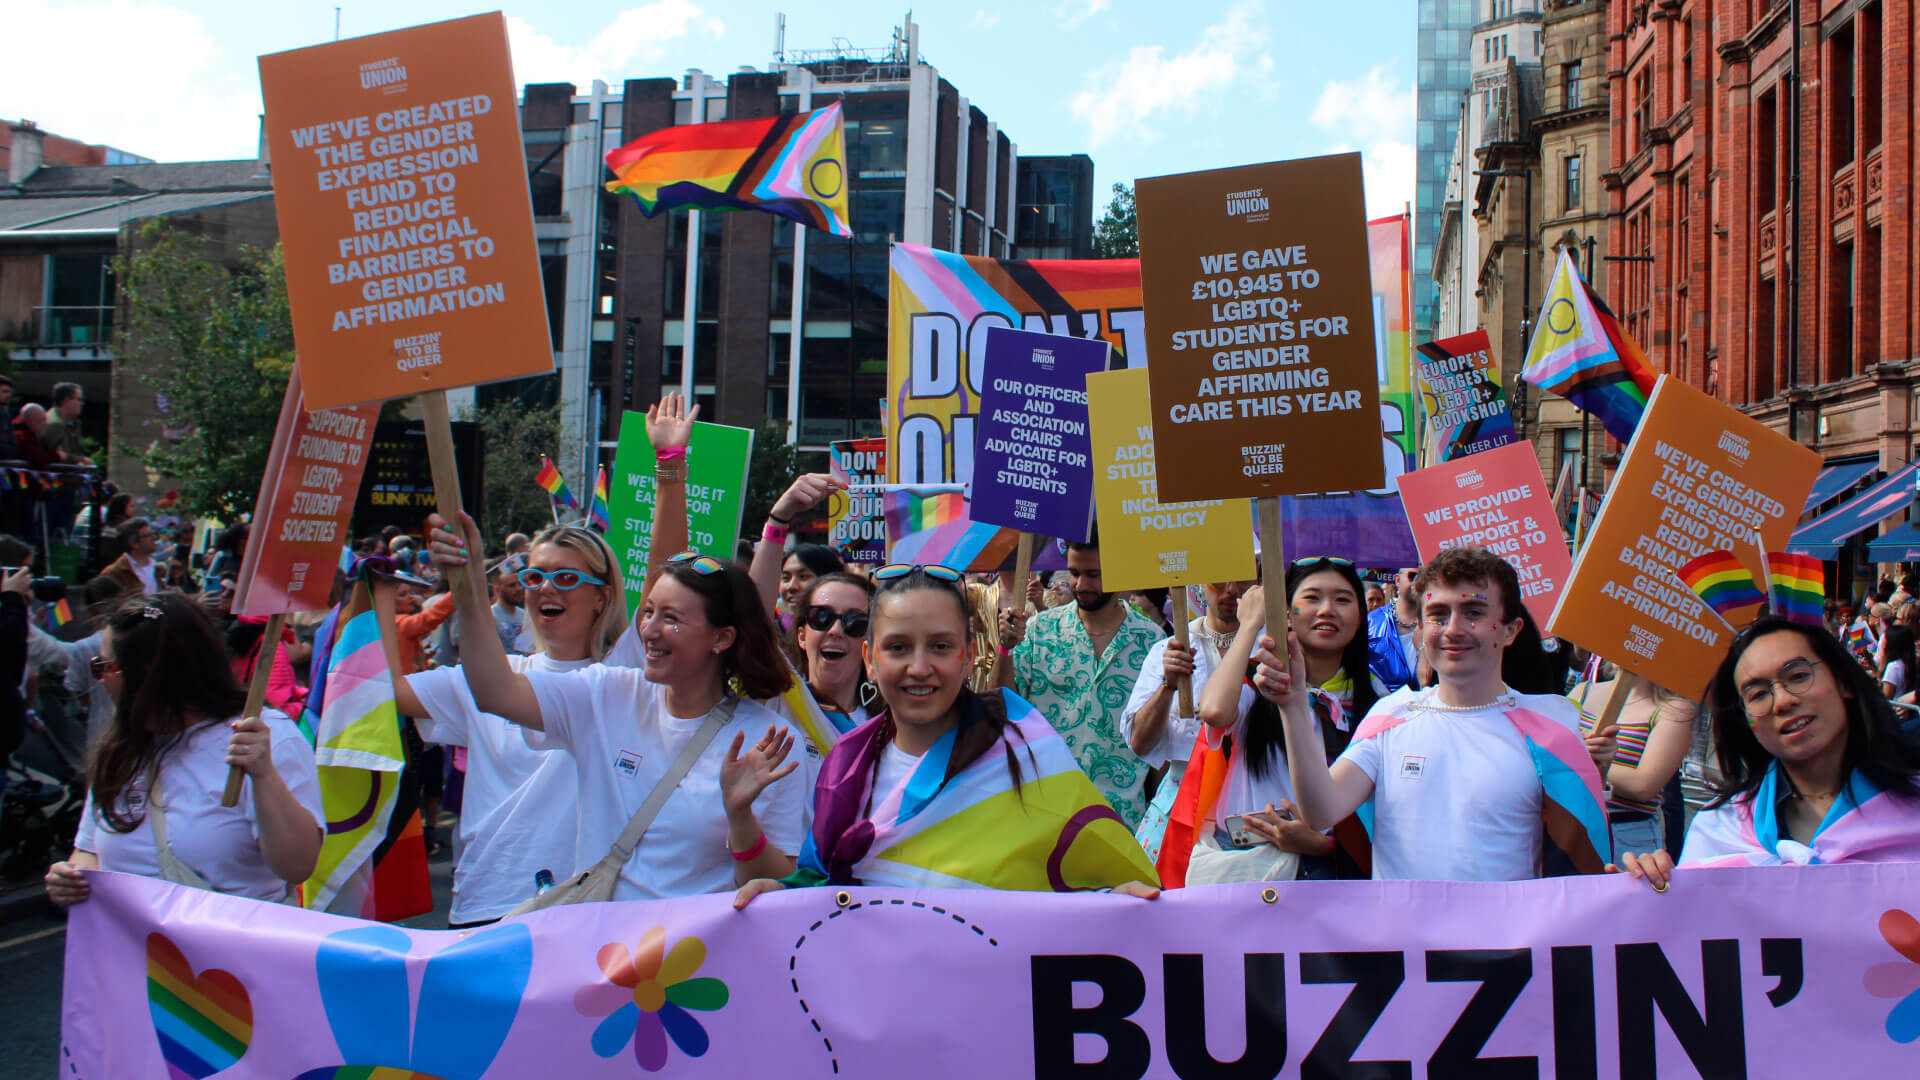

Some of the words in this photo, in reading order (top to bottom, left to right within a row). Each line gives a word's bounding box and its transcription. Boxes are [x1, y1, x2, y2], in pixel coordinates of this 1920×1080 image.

[360, 67, 408, 89] UNION
[291, 116, 371, 148] WE'VE
[375, 94, 492, 133] CREATED
[314, 141, 366, 167] THE
[370, 121, 474, 157] GENDER
[317, 144, 479, 191] EXPRESSION
[347, 180, 417, 209] FUND
[421, 173, 456, 195] TO
[353, 196, 457, 232] REDUCE
[1226, 197, 1269, 216] UNION
[339, 217, 478, 258] FINANCIAL
[328, 244, 456, 284] BARRIERS
[459, 237, 494, 260] TO
[1200, 253, 1238, 275] WE
[1242, 245, 1307, 270] GAVE
[362, 266, 467, 301] GENDER
[1191, 274, 1283, 300] £10,945
[1287, 269, 1320, 289] TO
[332, 282, 505, 331] AFFIRMATION
[1212, 297, 1302, 323] LGBTQ+
[394, 332, 442, 349] BUZZIN'
[1171, 321, 1295, 351] STUDENTS
[1300, 316, 1349, 338] FOR
[397, 354, 442, 372] QUEER
[405, 347, 422, 358] TO
[424, 343, 441, 354] BE
[1032, 352, 1055, 364] UNION
[1212, 345, 1310, 371] GENDER
[1422, 350, 1489, 379] EUROPE'S
[993, 378, 1022, 395] OUR
[1024, 383, 1089, 405] OFFICERS
[1198, 368, 1329, 398] AFFIRMING
[1430, 368, 1489, 394] LARGEST
[1024, 399, 1055, 415] AND
[1169, 400, 1234, 424] CARE
[1236, 396, 1292, 418] THIS
[1296, 390, 1362, 413] YEAR
[1437, 388, 1492, 411] LGBTQ+
[307, 410, 359, 438] SUPPORT
[992, 409, 1085, 436] ASSOCIATION
[1431, 400, 1506, 430] BOOKSHOP
[1010, 427, 1063, 447] CHAIRS
[1241, 444, 1285, 456] BUZZIN'
[1493, 435, 1508, 447] LIT
[1718, 435, 1750, 460] UNION
[297, 435, 347, 463] FUNDING
[347, 443, 362, 466] TO
[984, 438, 1056, 462] ADVOCATE
[1058, 450, 1087, 468] FOR
[1251, 454, 1266, 464] TO
[1268, 453, 1283, 463] BE
[302, 464, 343, 493] LGBTQ+
[1008, 458, 1059, 478] LGBTQ+
[1242, 463, 1284, 477] QUEER
[1654, 440, 1709, 480] WE'VE
[1709, 470, 1785, 519] CREATED
[712, 488, 727, 501] IT
[849, 474, 886, 493] BAN
[996, 471, 1067, 495] STUDENTS
[1660, 464, 1696, 494] THE
[1696, 483, 1765, 527] GENDER
[291, 492, 342, 516] STUDENT
[371, 492, 411, 505] BLINK
[686, 498, 711, 515] FOR
[849, 497, 885, 517] OUR
[1424, 507, 1453, 525] WE
[1454, 484, 1532, 517] PROVIDE
[1014, 510, 1036, 520] QUEER
[1140, 510, 1207, 531] POLICY
[1457, 509, 1509, 532] VITAL
[1523, 516, 1538, 530] &
[1651, 481, 1760, 546] EXPRESSION
[280, 519, 338, 542] SOCIETIES
[696, 531, 714, 546] TO
[1521, 530, 1546, 547] TO
[1660, 506, 1709, 541] FUND
[1713, 532, 1735, 552] TO
[1632, 575, 1704, 620] GENDER
[1600, 580, 1719, 648] AFFIRMATION
[1630, 624, 1664, 644] BUZZIN'
[1634, 635, 1646, 646] TO
[1647, 640, 1657, 651] BE
[1623, 639, 1655, 660] QUEER
[1031, 938, 1804, 1080] BUZZIN'
